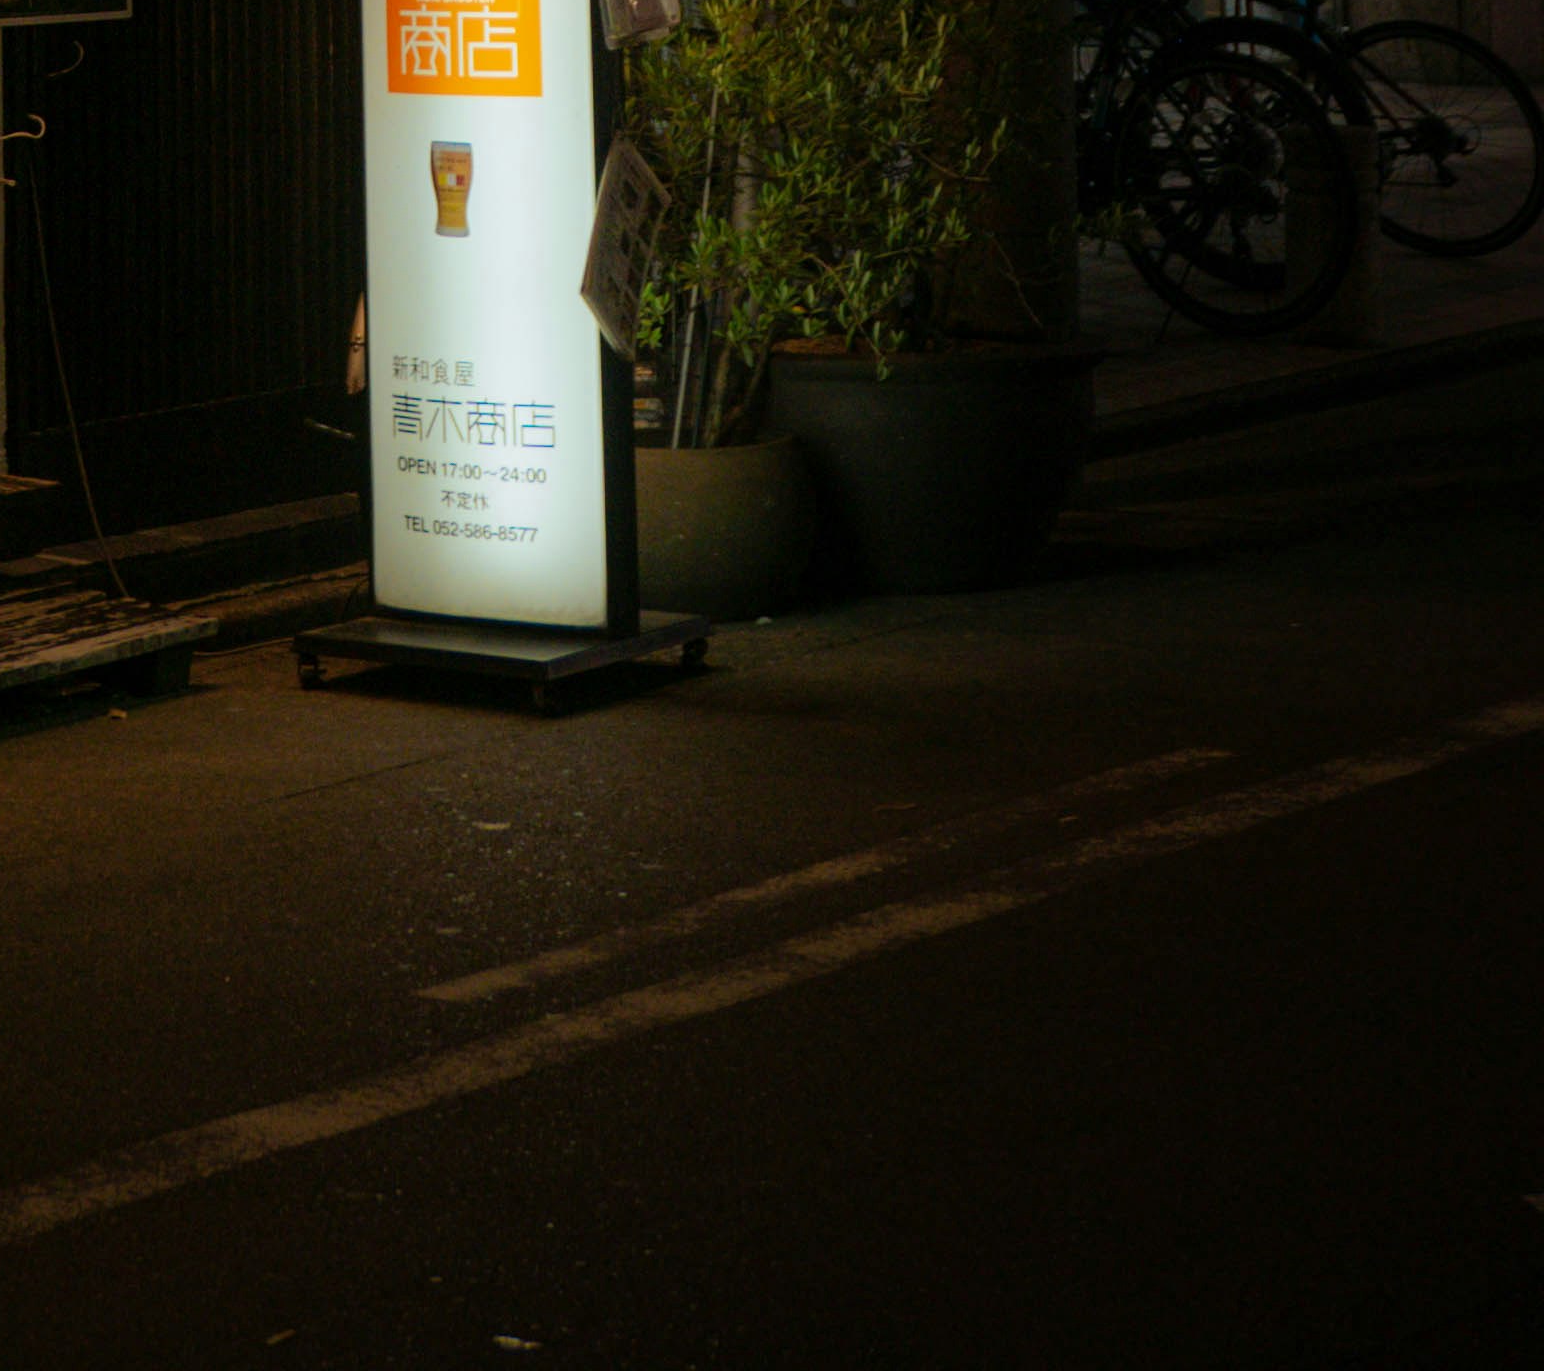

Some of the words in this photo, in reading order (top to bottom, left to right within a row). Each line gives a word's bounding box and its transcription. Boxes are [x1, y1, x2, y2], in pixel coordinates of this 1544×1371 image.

[398, 3, 519, 78] 商店
[392, 354, 477, 387] 新和食屋
[391, 391, 556, 448] 青木商店
[397, 456, 437, 476] OPEN
[440, 490, 490, 509] 不定休
[404, 514, 433, 534] TEL
